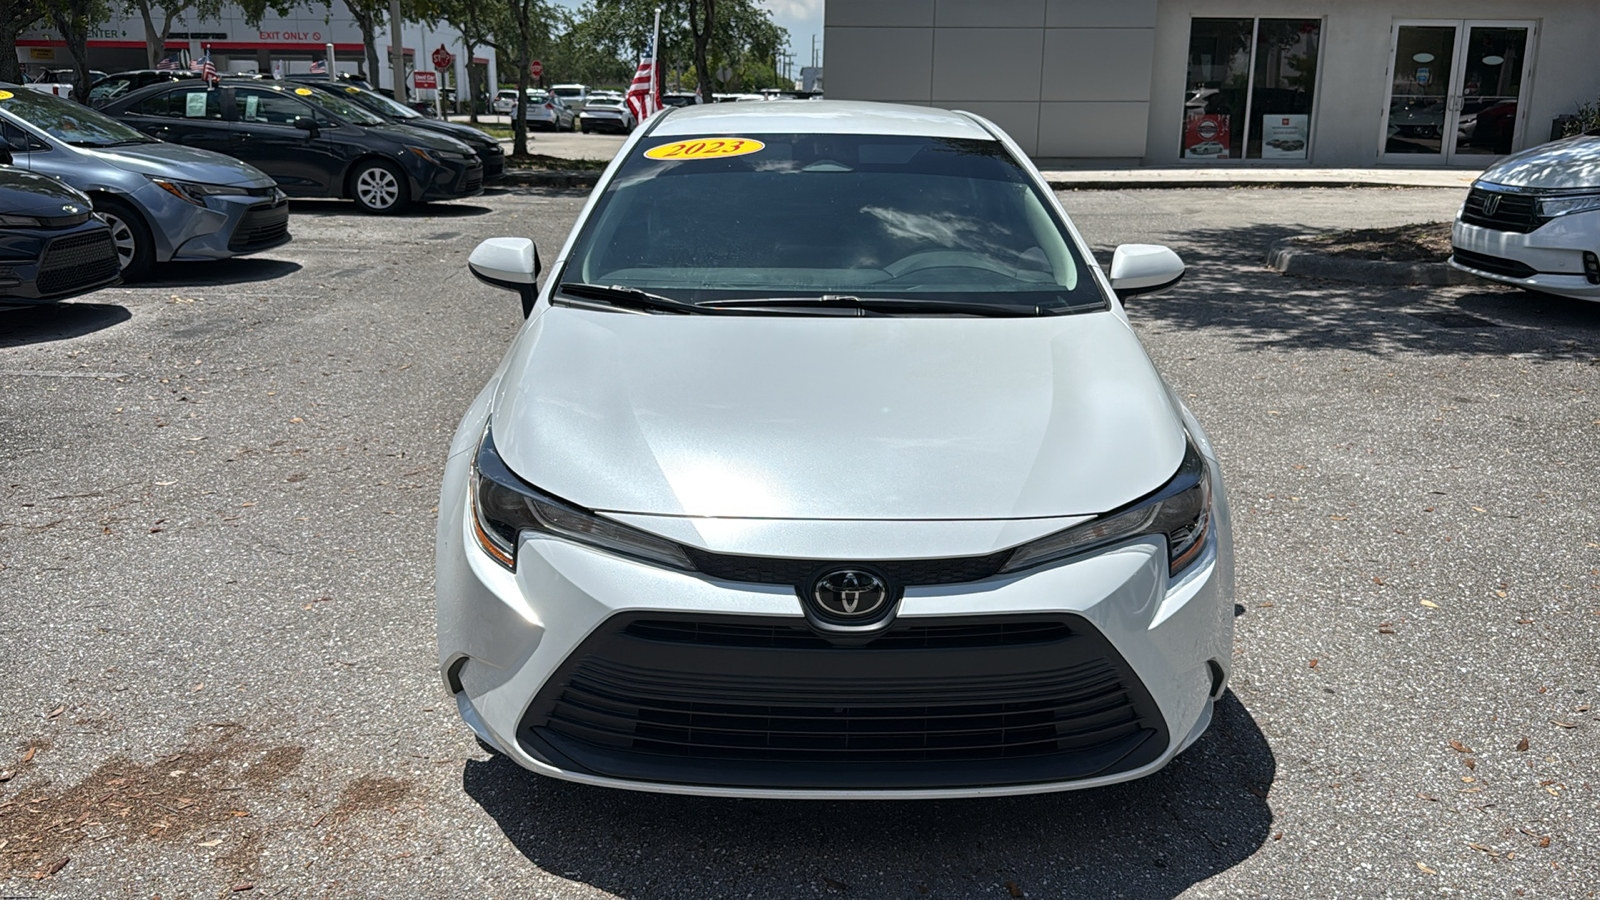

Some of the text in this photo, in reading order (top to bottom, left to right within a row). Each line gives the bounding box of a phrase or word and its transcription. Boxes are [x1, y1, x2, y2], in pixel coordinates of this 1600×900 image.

[87, 29, 118, 38] ENTER
[259, 31, 309, 40] EXIT ONLY
[663, 140, 745, 158] 2023
